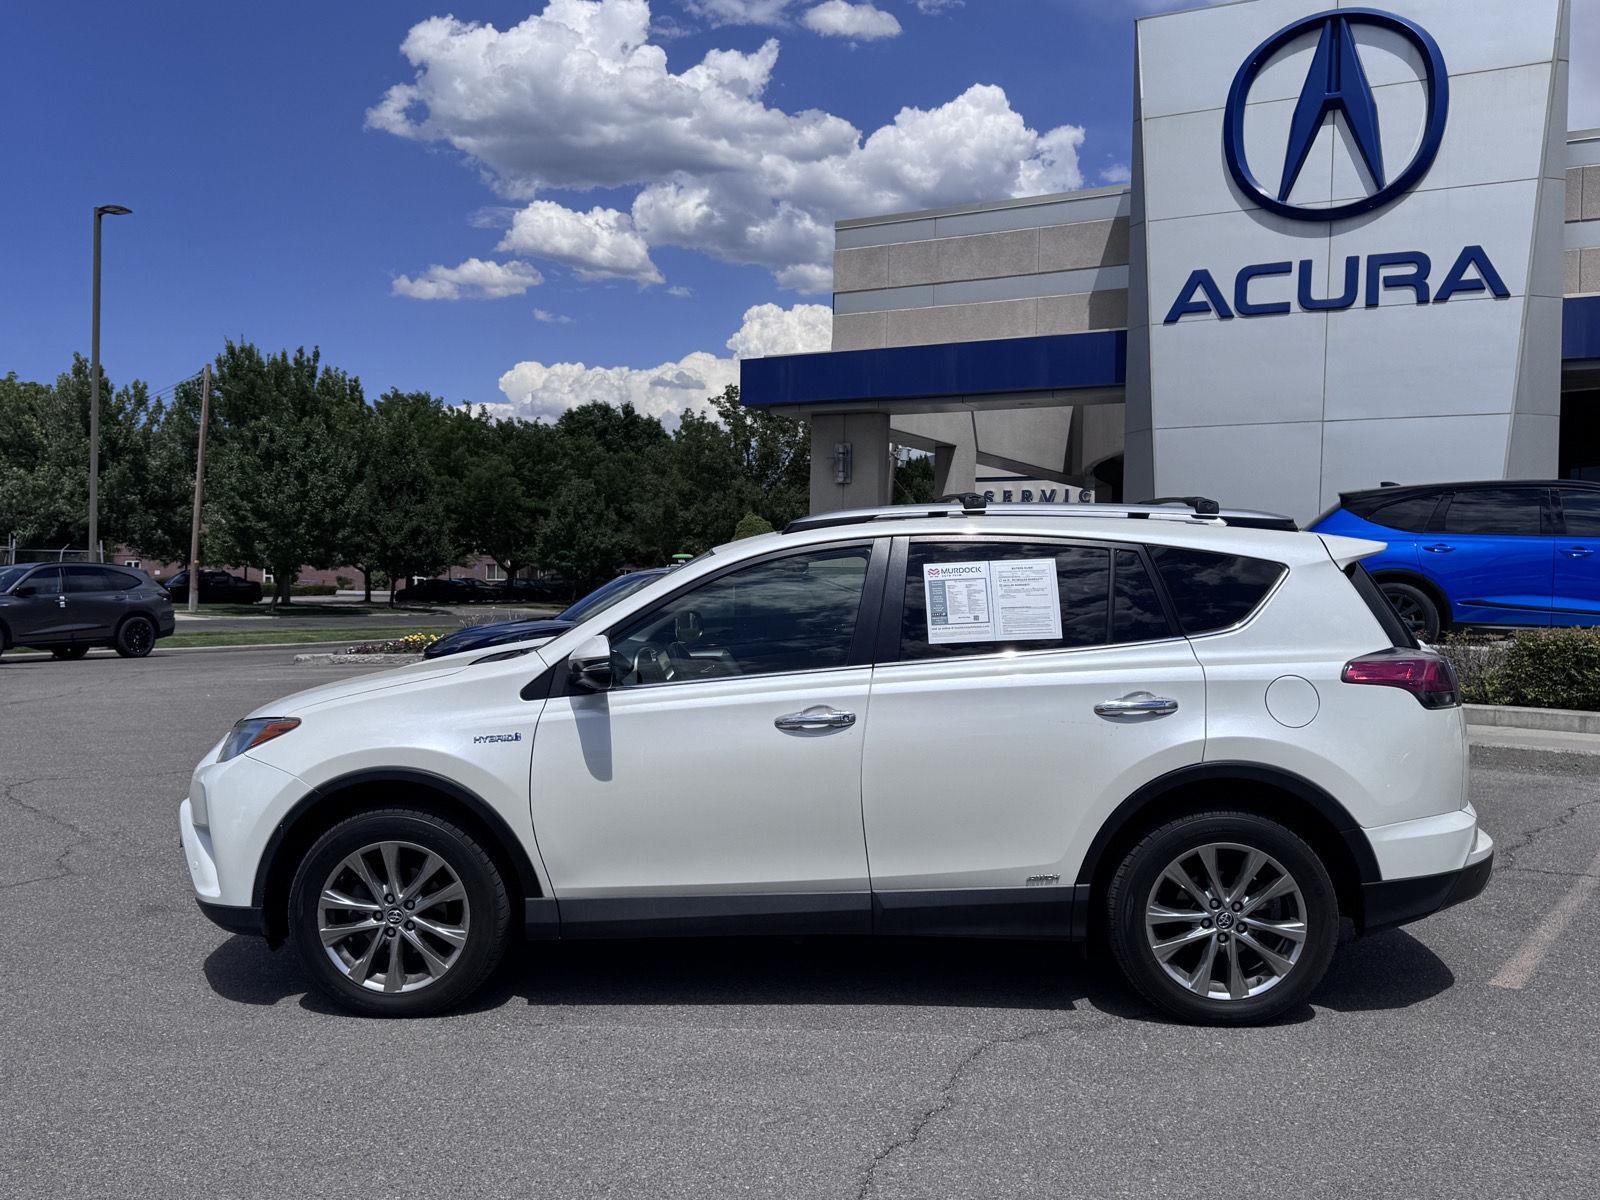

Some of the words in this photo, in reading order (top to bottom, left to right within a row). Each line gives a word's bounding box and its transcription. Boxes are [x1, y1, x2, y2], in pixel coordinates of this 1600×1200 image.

[1163, 245, 1511, 325] ACURA
[940, 566, 982, 575] MURDOCK
[473, 734, 513, 744] HYBRID
